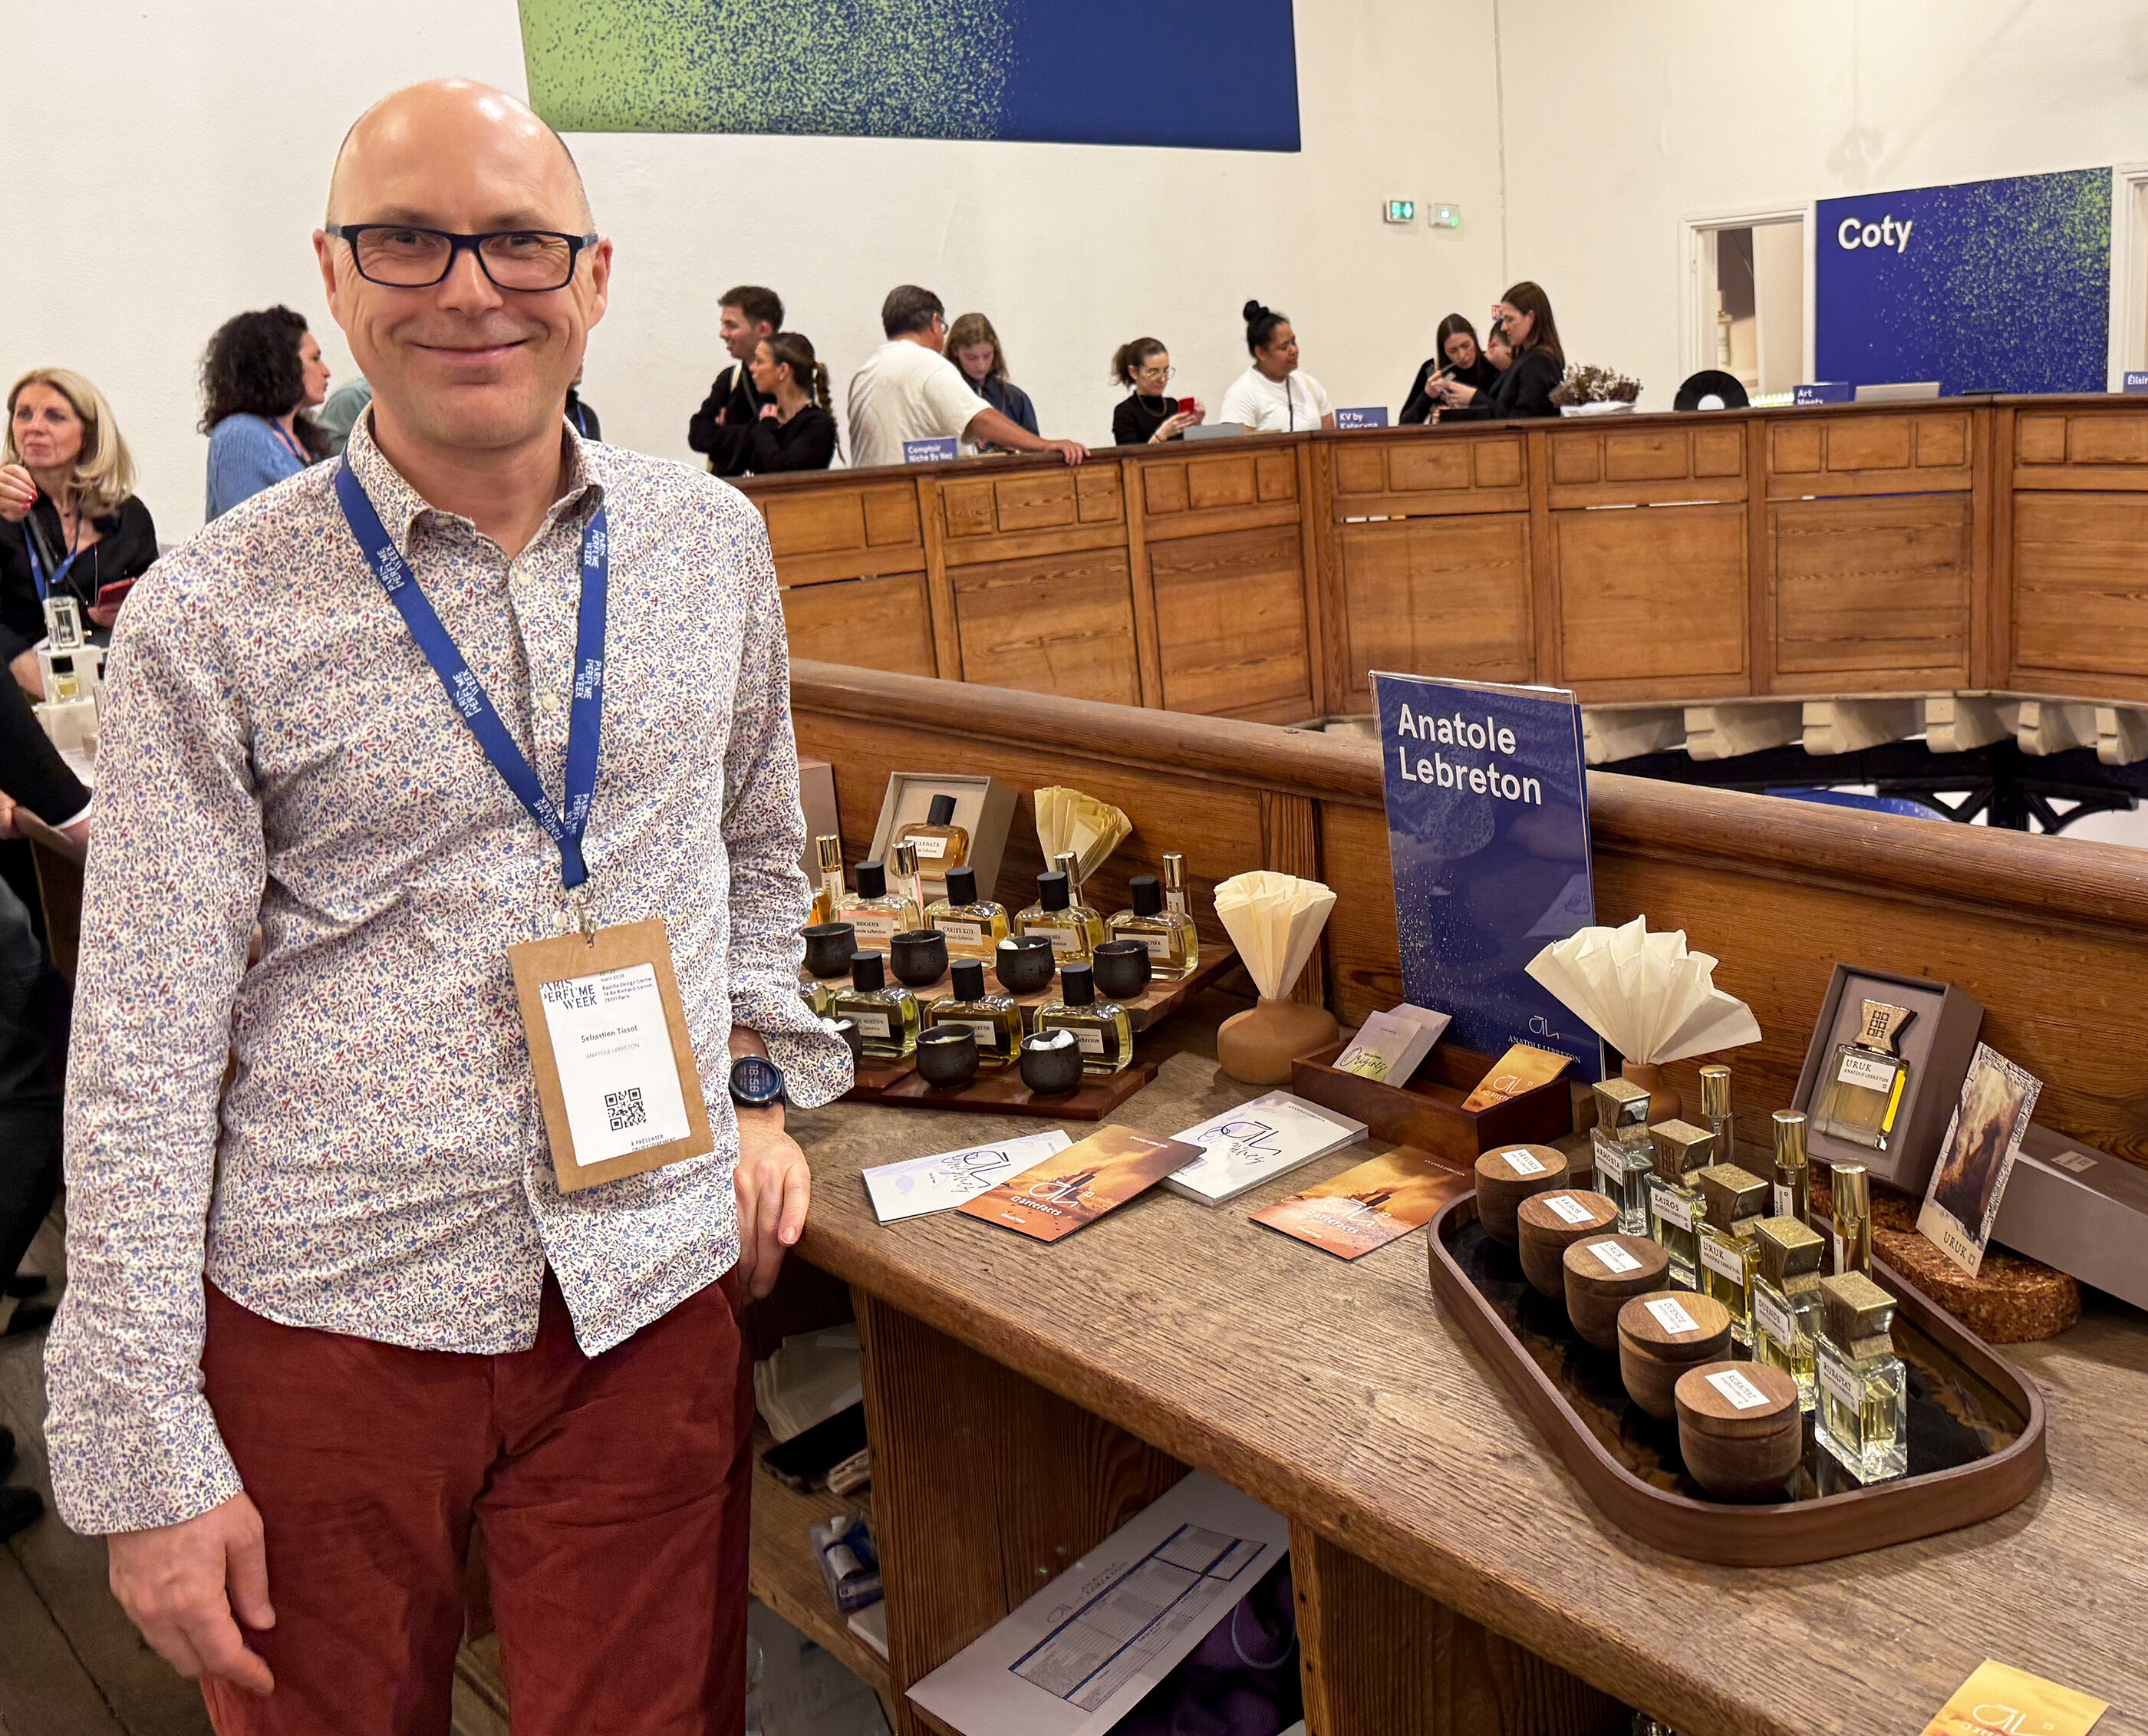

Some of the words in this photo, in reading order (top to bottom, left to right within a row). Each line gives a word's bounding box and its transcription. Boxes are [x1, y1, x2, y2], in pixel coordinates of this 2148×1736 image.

[1838, 215, 1913, 253] Coty
[1797, 389, 1813, 397] Art
[1339, 413, 1351, 421] KV
[1352, 413, 1363, 422] by
[908, 445, 941, 454] Comptoir
[384, 542, 404, 570] WEEK
[591, 529, 600, 568] PERFUME
[376, 545, 405, 588] PERFUME
[376, 564, 397, 592] PARIS
[460, 667, 480, 695] WEEK
[575, 673, 584, 698] WEEK
[583, 658, 594, 700] PERFUME
[593, 660, 601, 686] PARIS
[452, 670, 483, 714] PERFUME
[453, 689, 473, 718] PARIS
[1398, 703, 1516, 755] Anatole
[1399, 746, 1542, 805] Lebreton
[538, 796, 559, 822] WEEK
[562, 995, 598, 1010] WEEK
[617, 1025, 638, 1036] Tissot
[749, 1064, 759, 1092] 18:56
[1843, 1069, 1864, 1077] ANATOLE
[1865, 1072, 1889, 1082] LEBRETON
[1846, 1059, 1872, 1072] URUK
[1018, 1197, 1062, 1217] artefacts
[1654, 1193, 1680, 1212] KAIROS
[1313, 1212, 1359, 1235] artefacts
[1703, 1241, 1725, 1260] URUK
[1944, 1231, 1967, 1259] URUK
[1758, 1300, 1781, 1324] DUENDE
